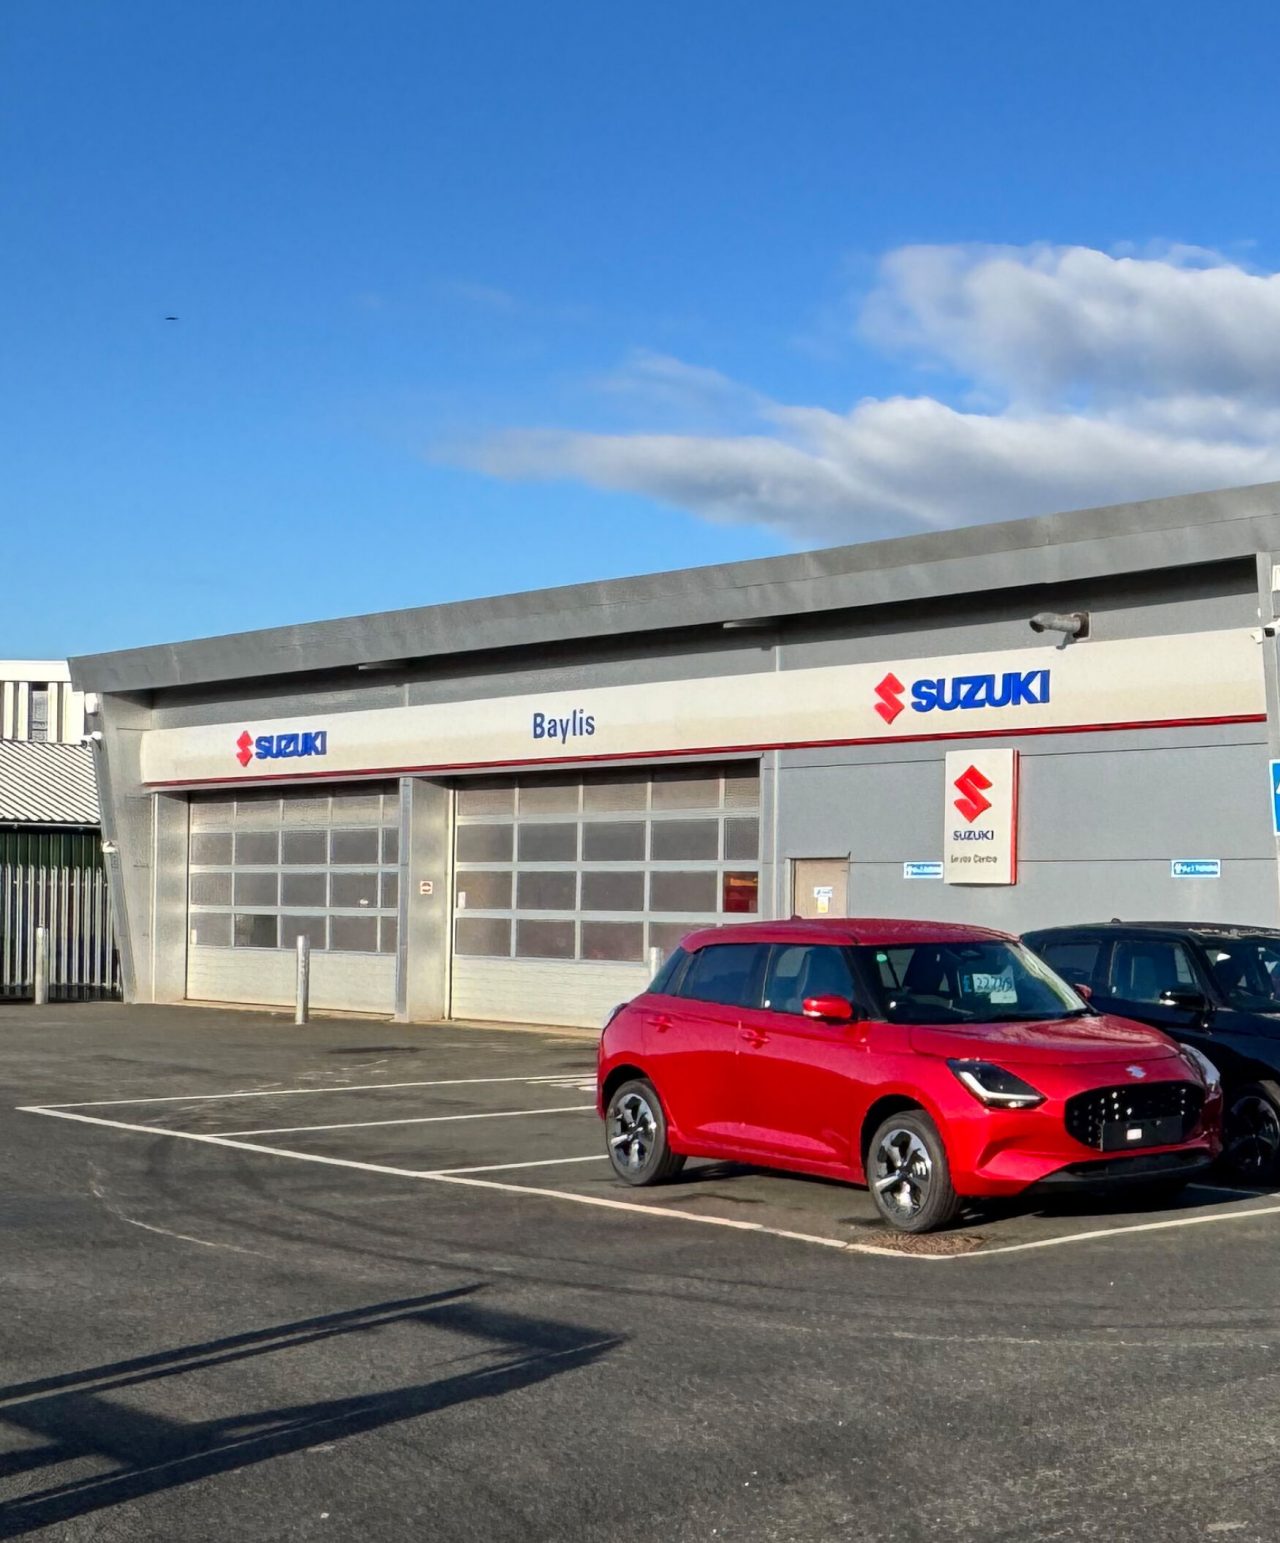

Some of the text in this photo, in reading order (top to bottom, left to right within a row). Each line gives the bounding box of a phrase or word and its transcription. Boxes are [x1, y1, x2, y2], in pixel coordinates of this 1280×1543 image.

[911, 669, 1050, 712] SUZUKI
[533, 708, 595, 744] Baylis
[255, 730, 327, 759] SUZUKI
[953, 829, 995, 841] SUZUKI
